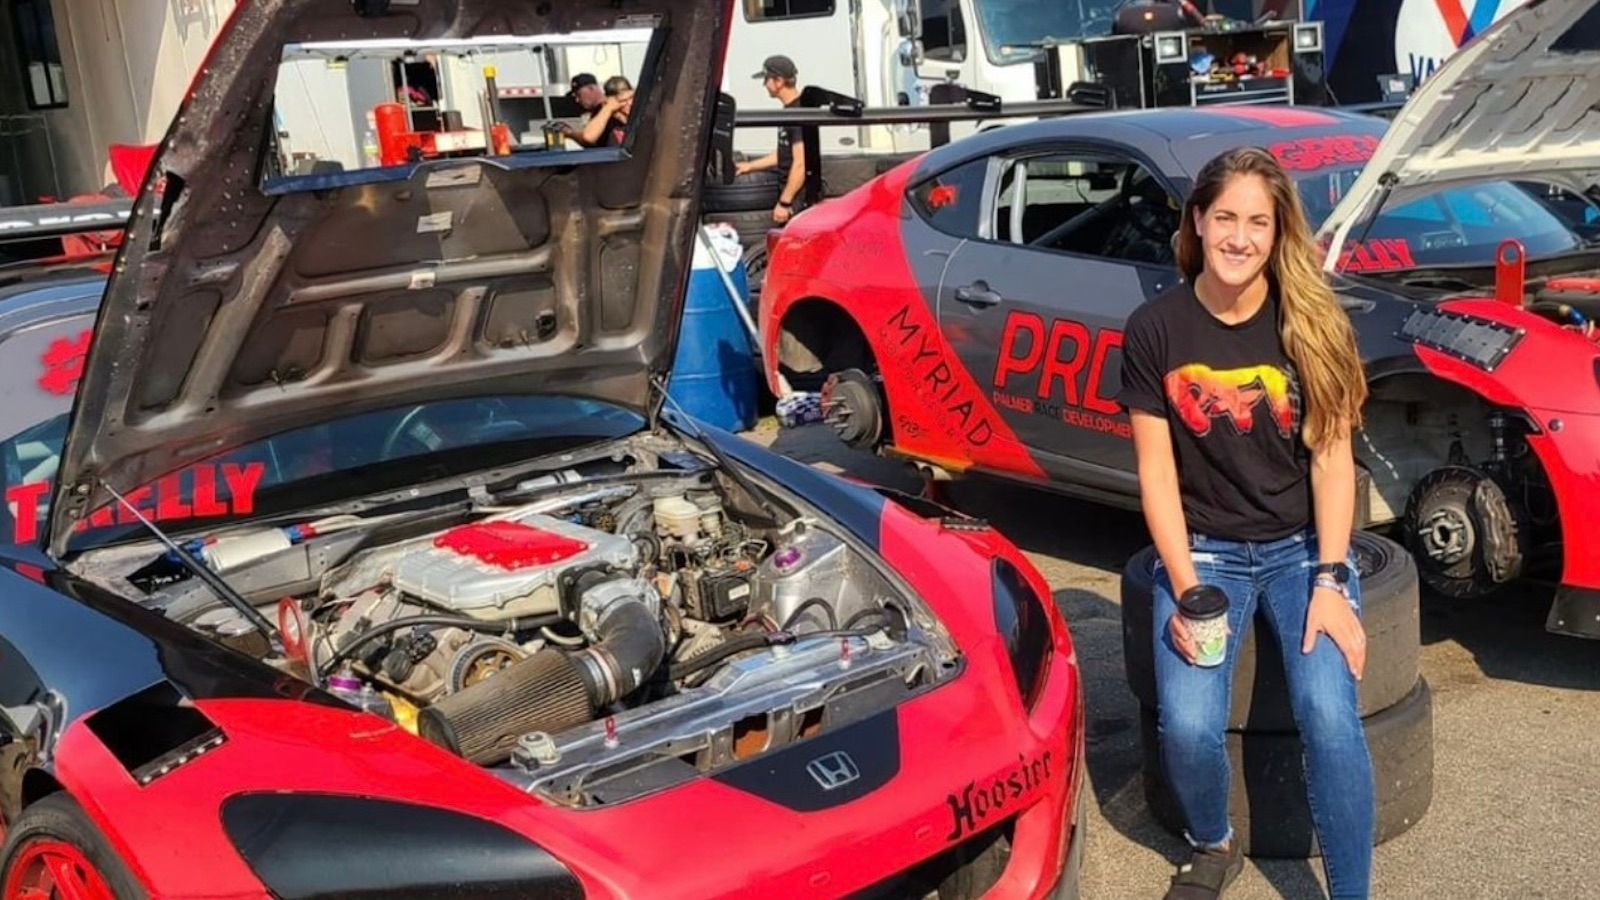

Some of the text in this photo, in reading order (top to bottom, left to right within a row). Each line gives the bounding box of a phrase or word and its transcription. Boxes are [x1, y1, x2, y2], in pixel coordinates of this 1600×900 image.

[888, 304, 993, 446] MYRIAD
[993, 391, 1034, 414] PALMER
[1062, 408, 1132, 439] DEVELOPME
[947, 750, 1051, 841] Hoosier
